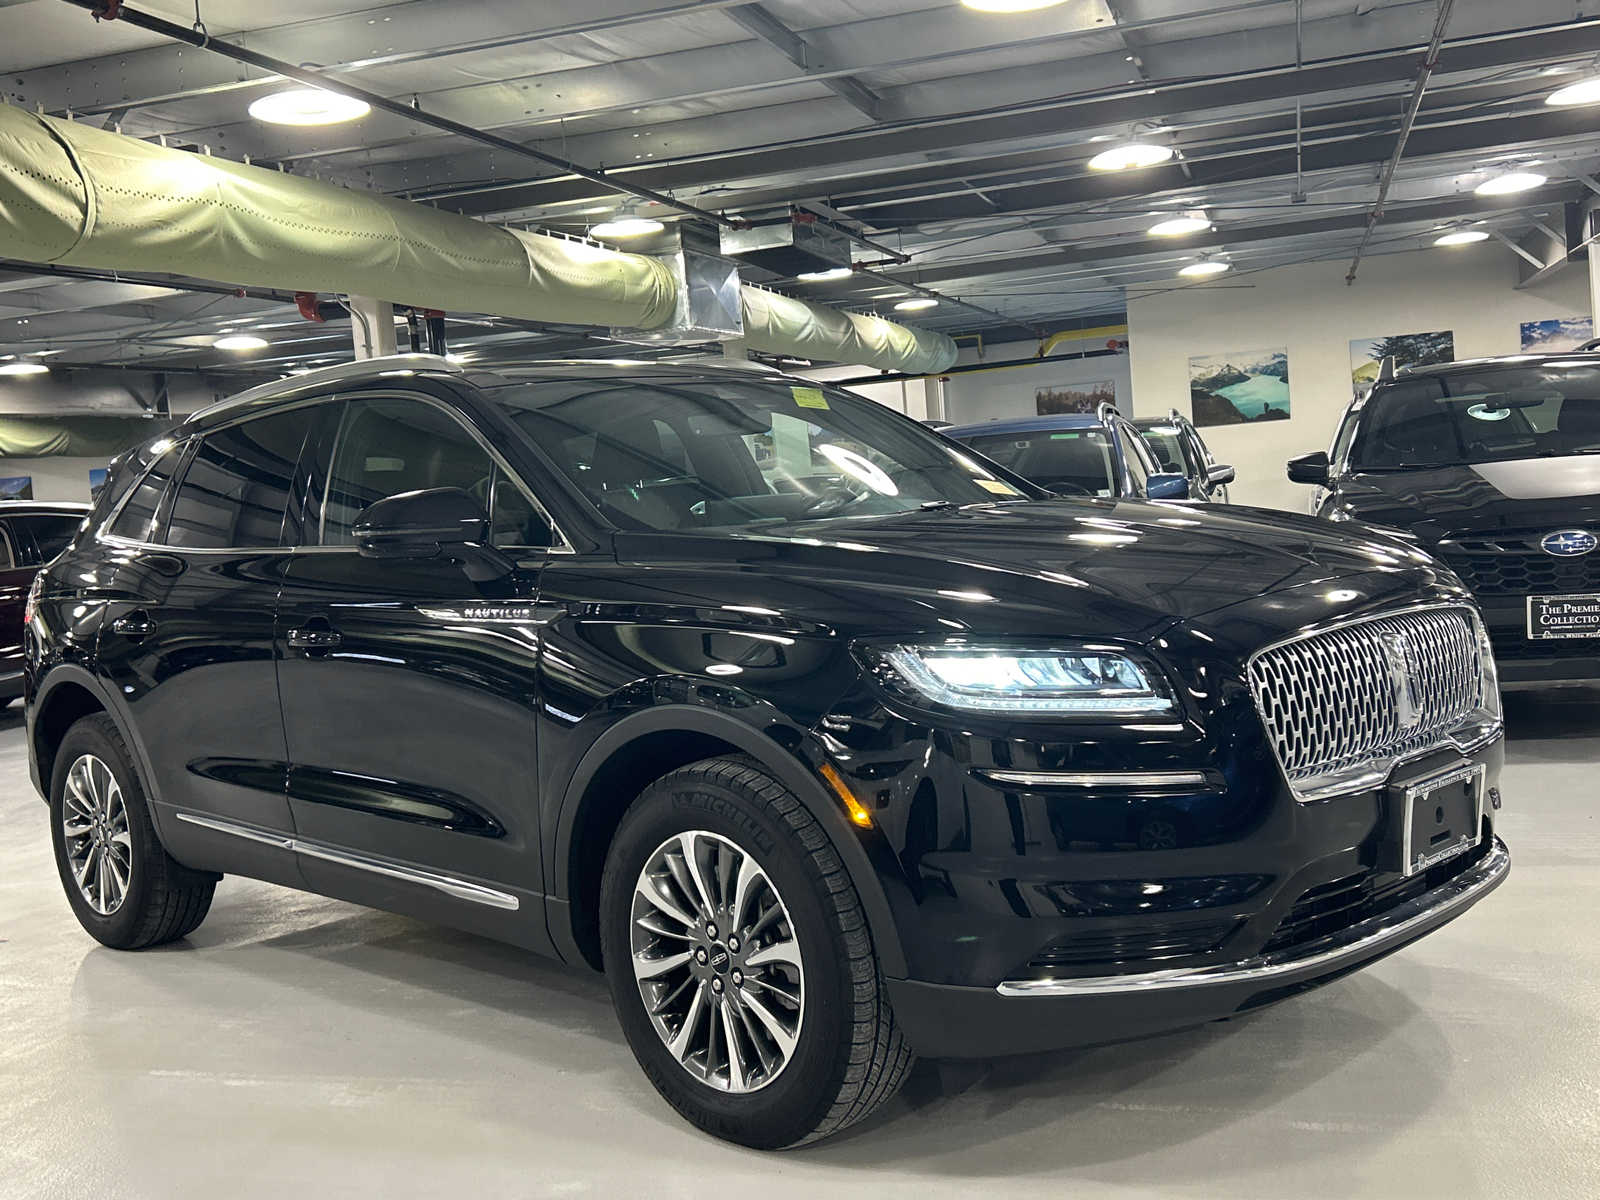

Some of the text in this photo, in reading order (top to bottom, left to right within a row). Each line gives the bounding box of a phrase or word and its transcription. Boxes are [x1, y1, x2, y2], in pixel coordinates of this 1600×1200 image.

[463, 608, 530, 618] NAUTILUS
[1540, 605, 1561, 614] THE
[1540, 615, 1600, 624] COLLECTIO
[691, 793, 775, 853] MICHELIN
